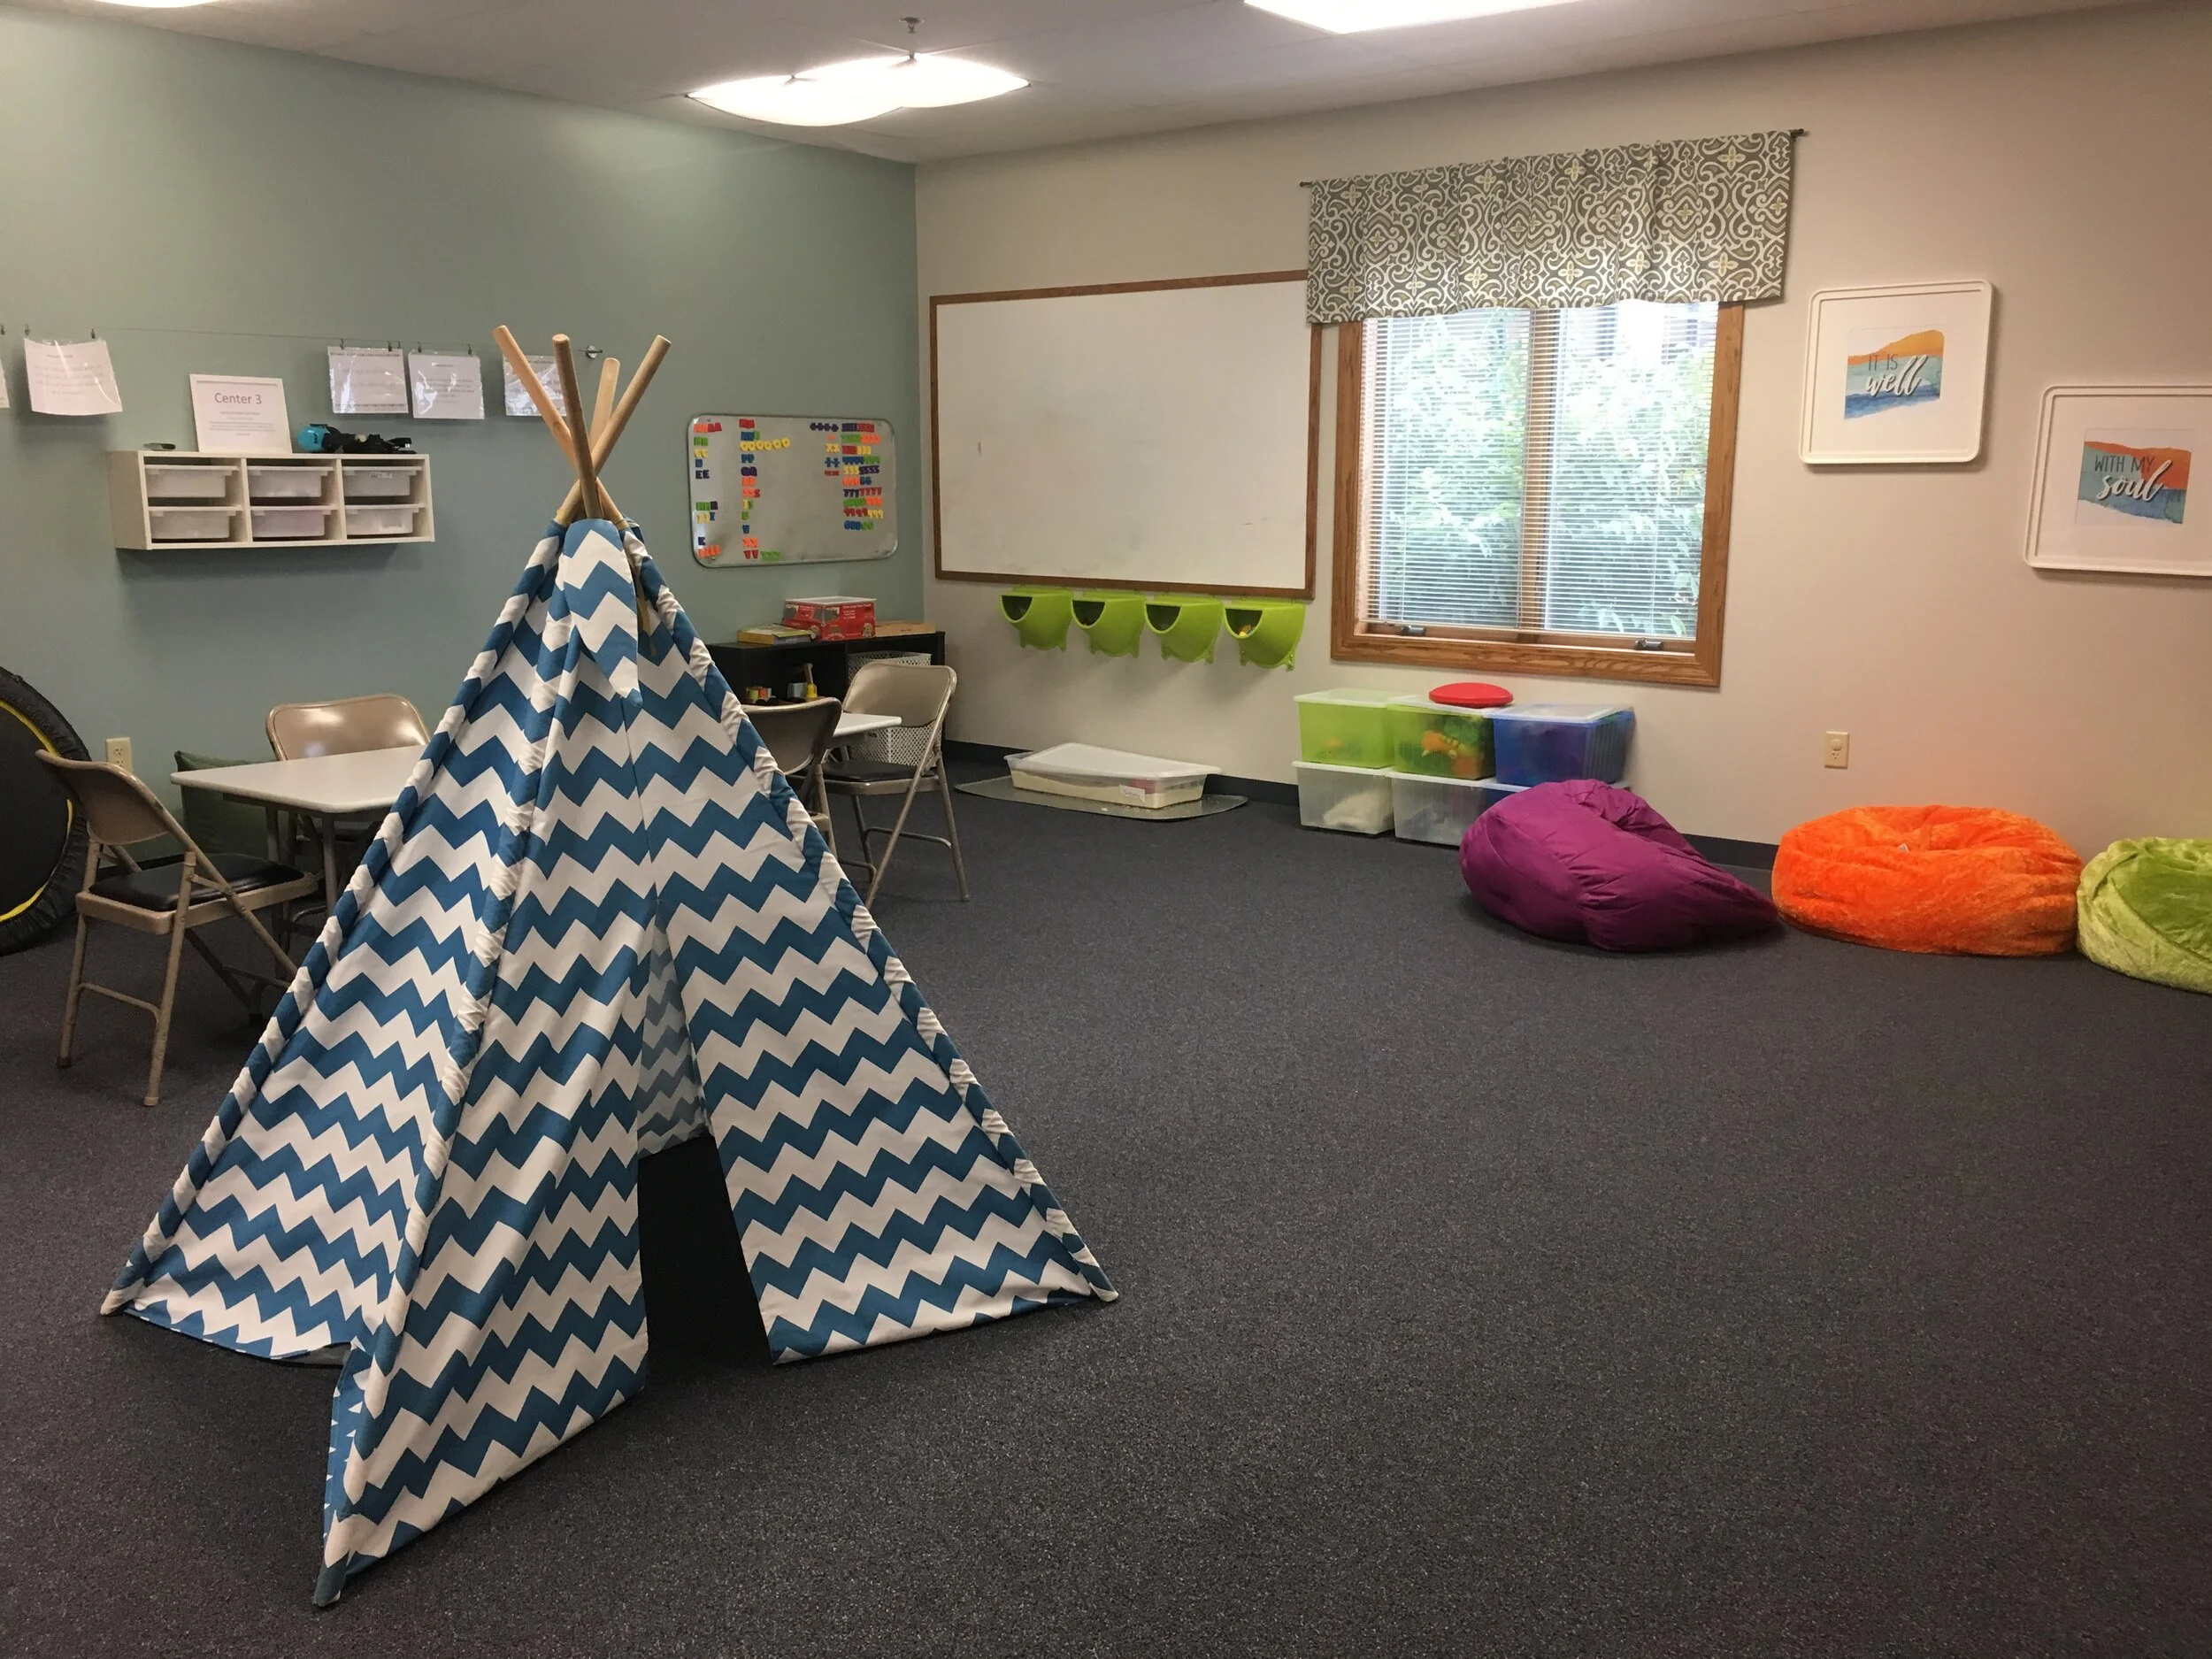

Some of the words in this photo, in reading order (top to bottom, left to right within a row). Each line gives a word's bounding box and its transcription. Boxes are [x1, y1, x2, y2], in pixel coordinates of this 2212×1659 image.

[1869, 354, 1880, 371] IT
[1886, 354, 1899, 371] IS
[1865, 354, 1929, 397] well
[214, 393, 251, 404] Center
[255, 394, 263, 405] 3
[2094, 456, 2125, 472] WITH
[2131, 456, 2155, 473] MY
